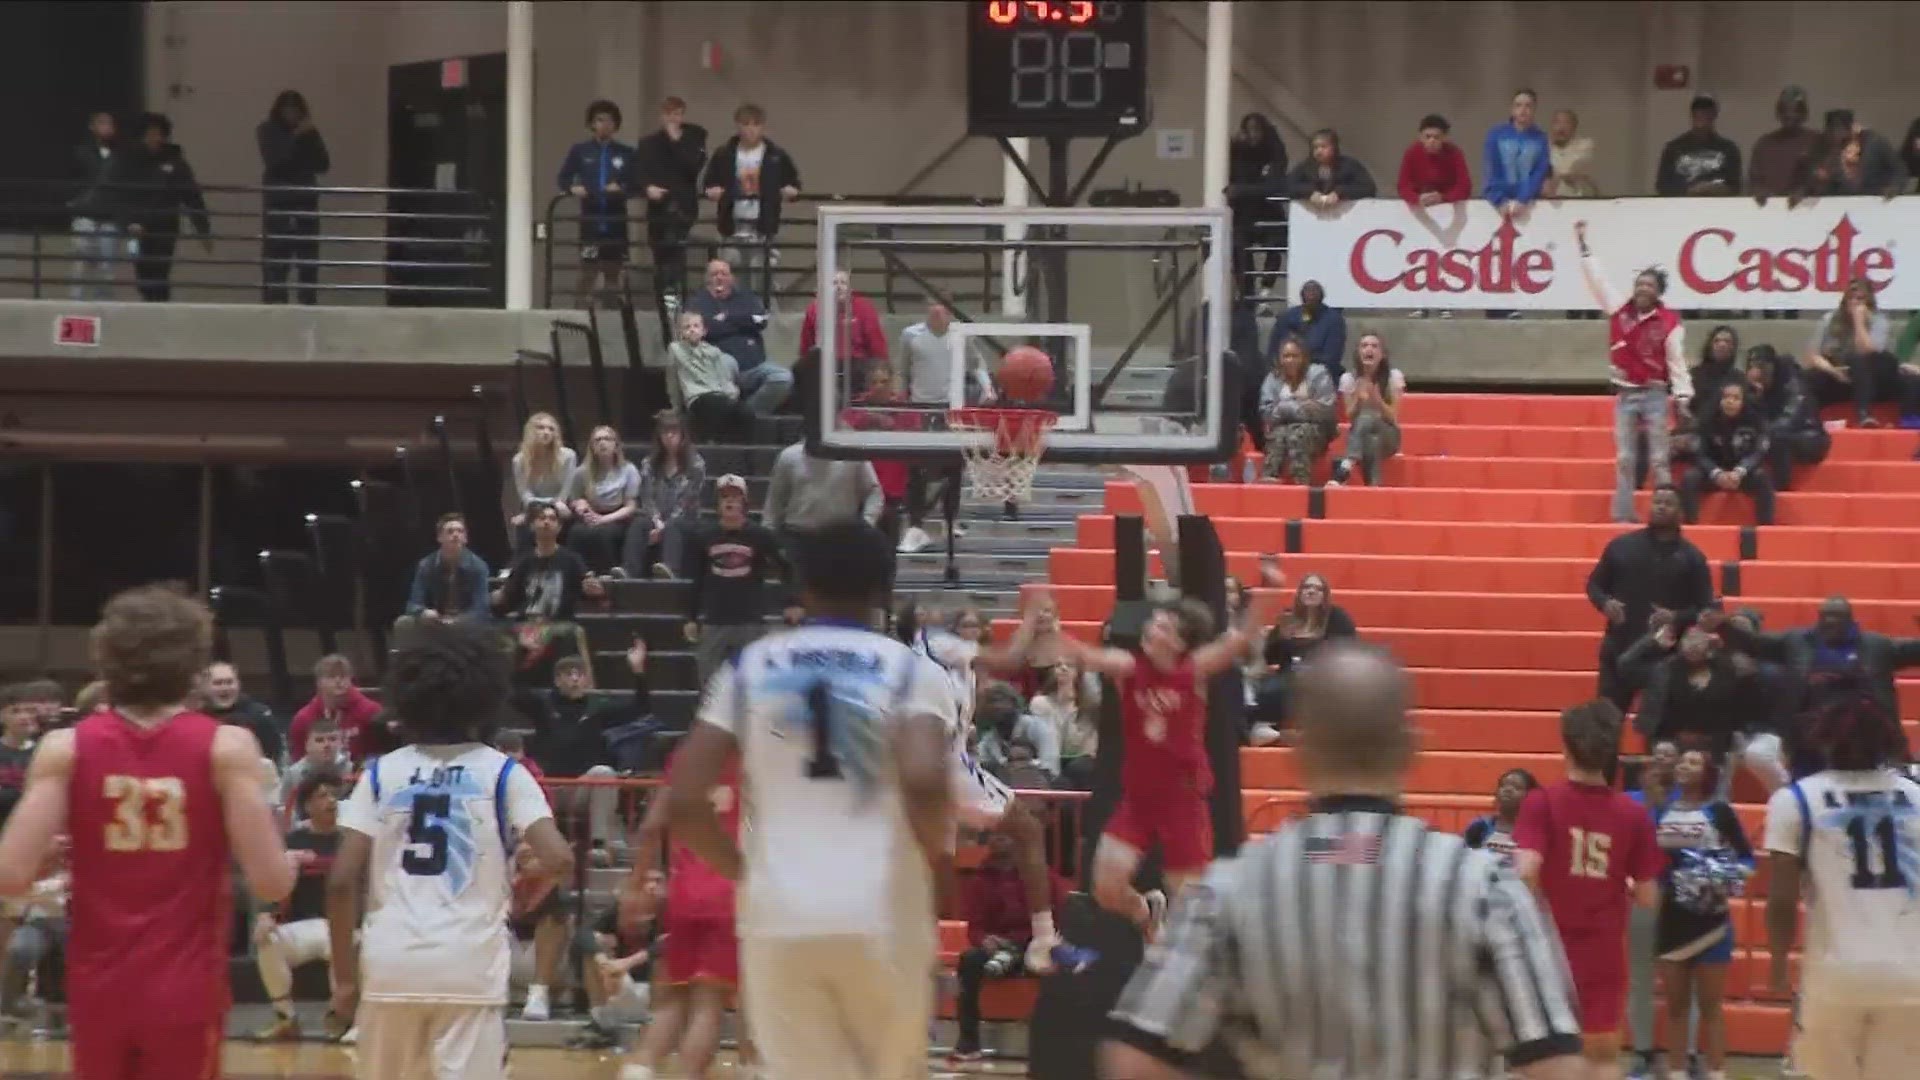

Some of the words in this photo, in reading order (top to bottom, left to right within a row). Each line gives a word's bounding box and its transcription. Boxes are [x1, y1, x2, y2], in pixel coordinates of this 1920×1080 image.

[1350, 214, 1554, 294] Castle
[1679, 213, 1895, 294] Castle
[102, 774, 189, 852] 33
[402, 793, 450, 876] 5
[1846, 815, 1908, 889] 11
[1568, 827, 1611, 879] 15
